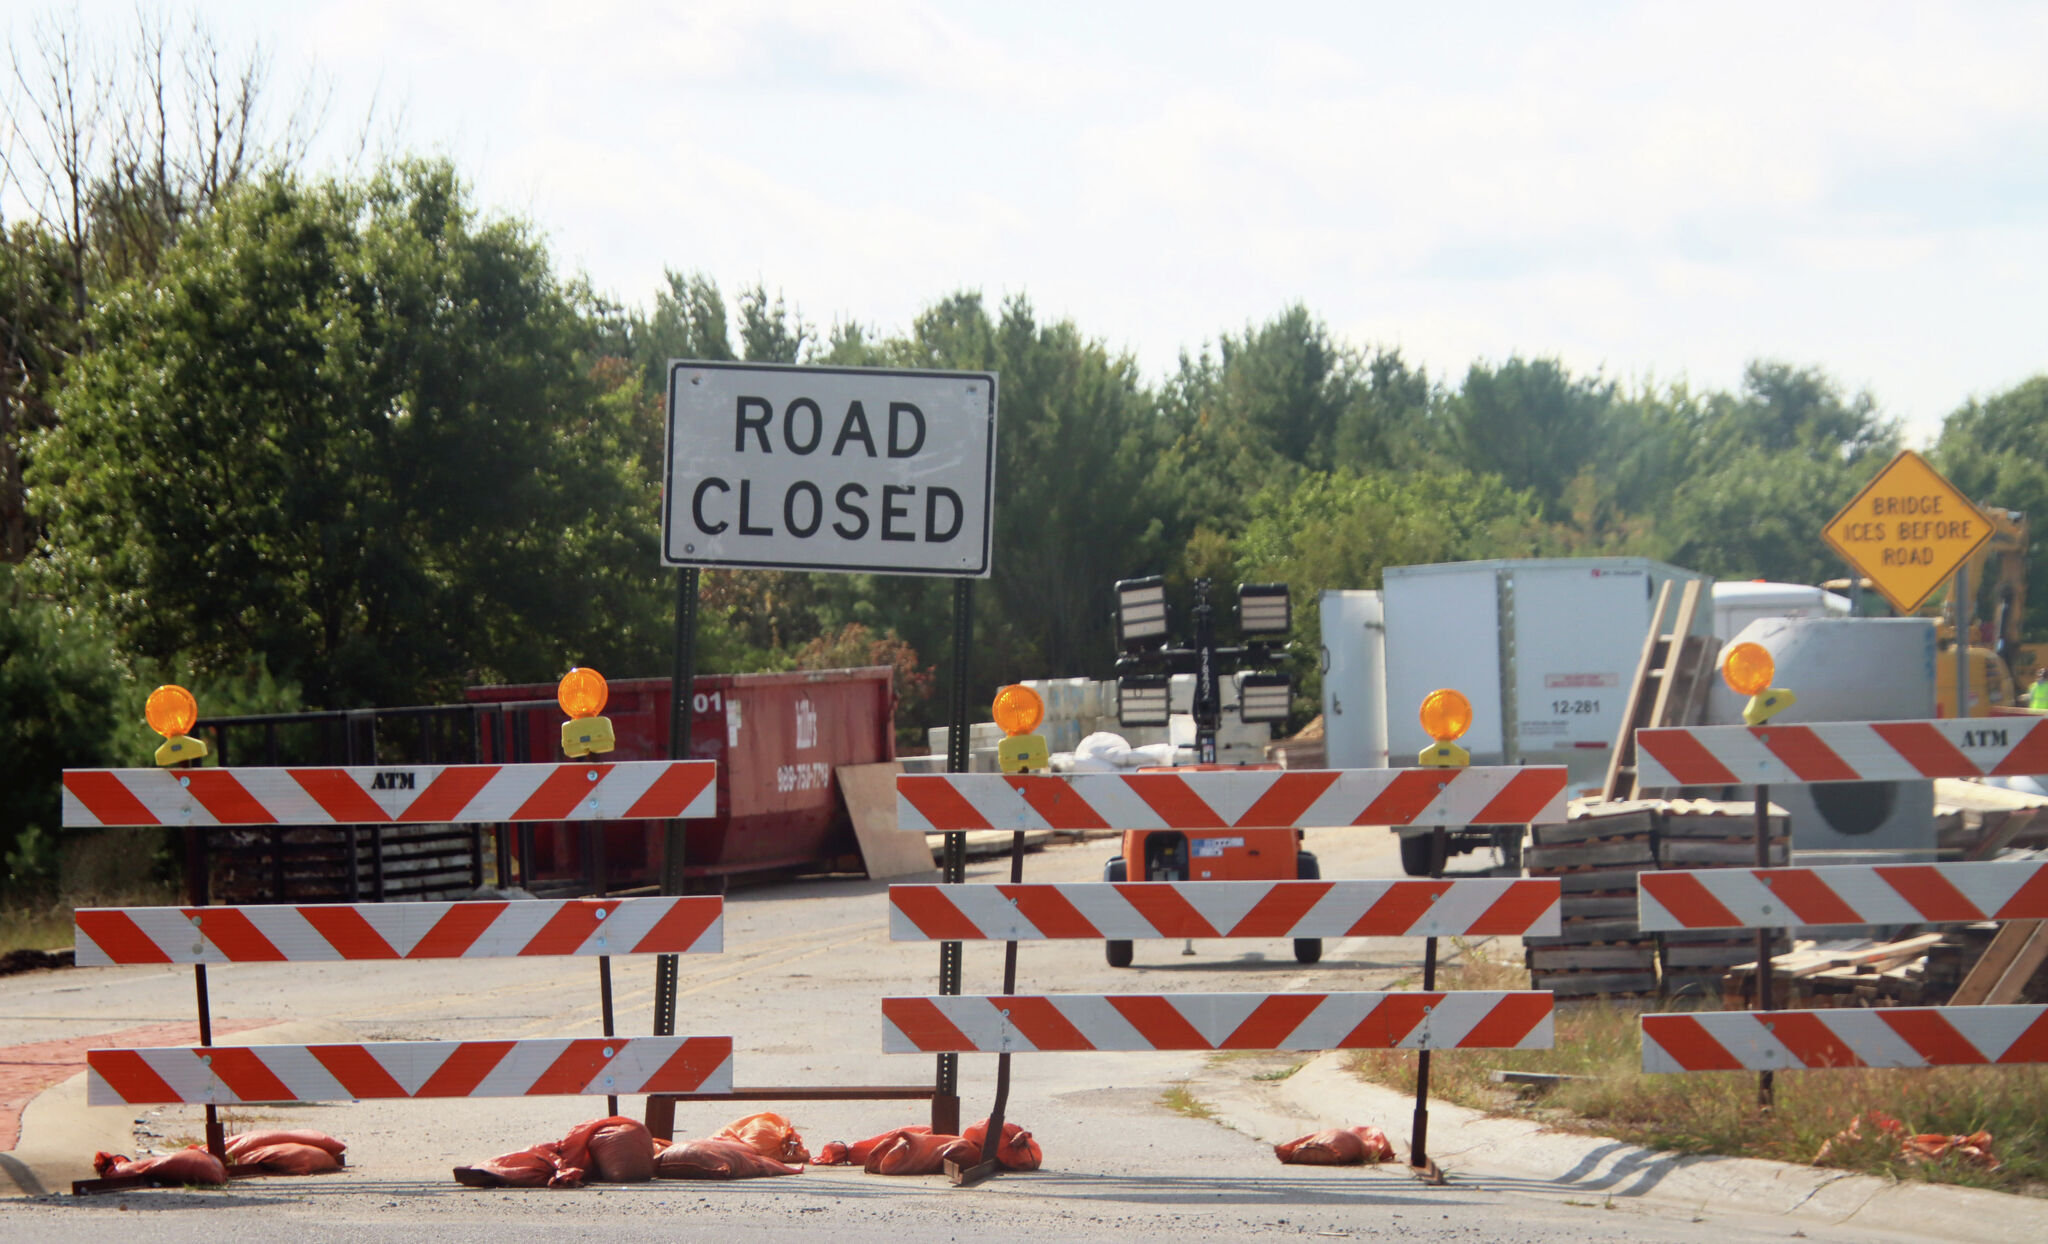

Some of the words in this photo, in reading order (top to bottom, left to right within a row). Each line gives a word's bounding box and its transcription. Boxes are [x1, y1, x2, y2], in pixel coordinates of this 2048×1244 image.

[735, 395, 927, 459] ROAD
[692, 476, 964, 543] CLOSED
[1872, 495, 1944, 516] BRIDGE
[1843, 522, 1886, 542] ICES
[1897, 519, 1973, 541] BEFORE
[1881, 546, 1935, 567] ROAD
[1552, 700, 1600, 714] 12-281
[1961, 729, 2009, 748] ATM
[371, 772, 415, 790] ATM
